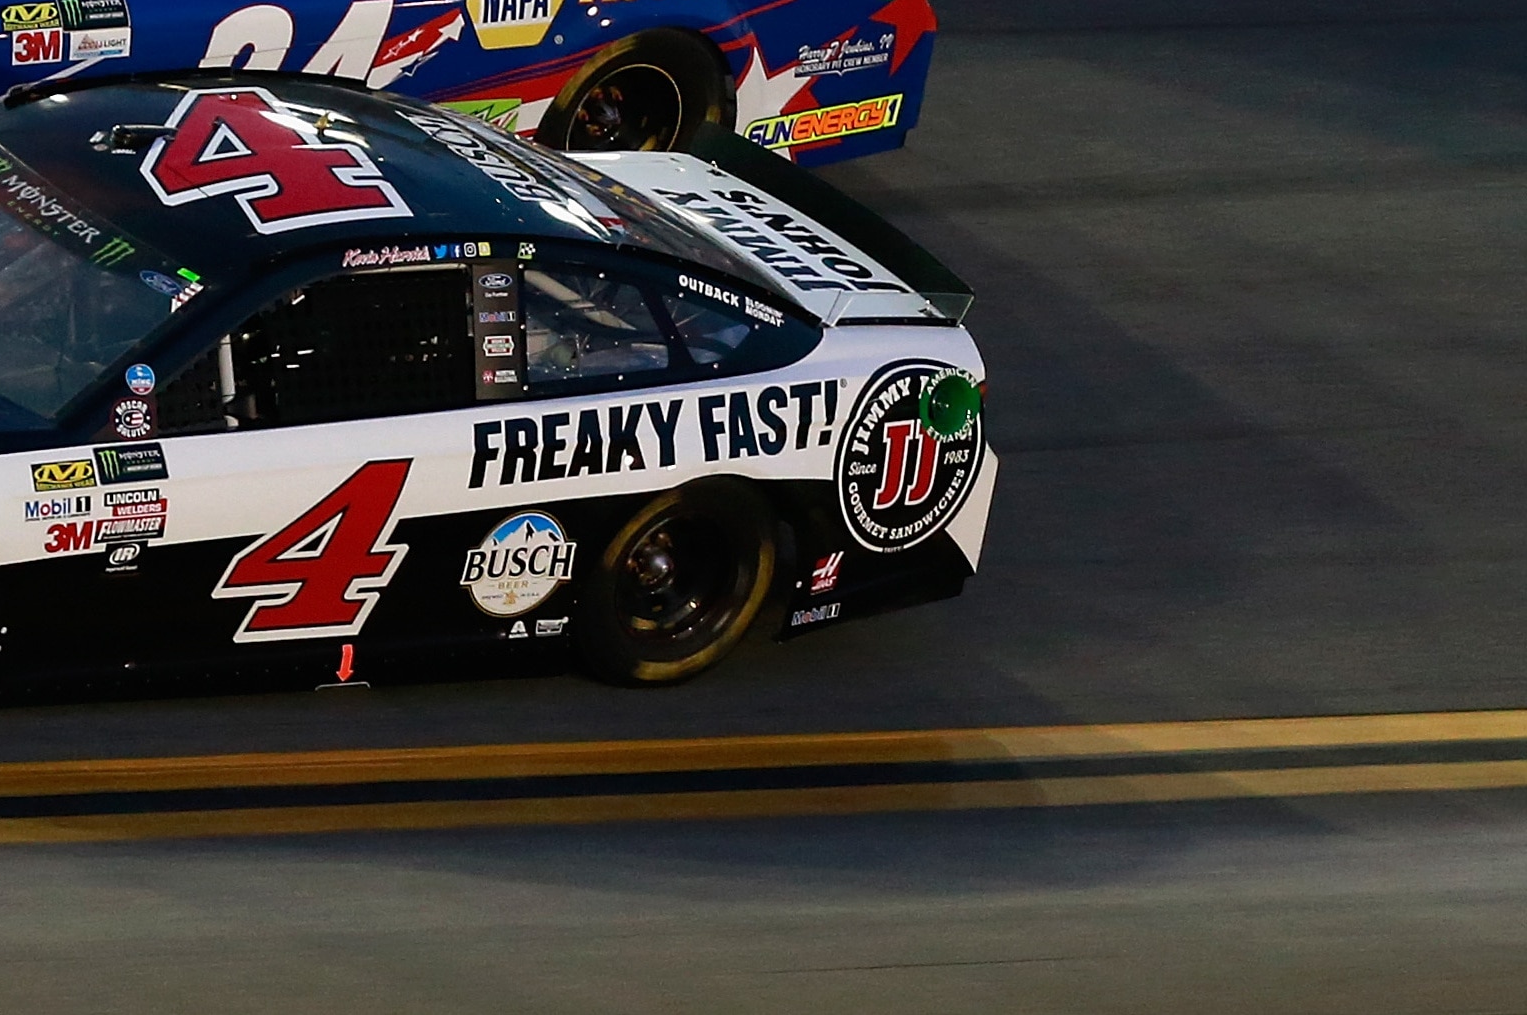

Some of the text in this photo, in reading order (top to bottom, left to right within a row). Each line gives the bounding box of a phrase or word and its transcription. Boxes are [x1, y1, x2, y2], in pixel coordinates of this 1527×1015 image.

[15, 30, 60, 62] 3M
[103, 38, 127, 47] LIGHT
[796, 53, 889, 74] HONORARY PIT CREW MEMBER
[138, 86, 415, 236] 4
[2, 174, 101, 244] MONSTER
[711, 190, 912, 294] JOHN'S
[679, 275, 739, 307] OUTBACK
[926, 367, 977, 396] AMERICAN
[115, 399, 148, 415] NASCAR
[852, 377, 911, 456] JIMMY
[117, 423, 151, 438] SALUTES
[468, 380, 839, 488] FREAKY FAST!
[119, 449, 160, 460] MONSTER
[848, 449, 970, 476] Since 1983
[873, 419, 940, 509] JJ
[25, 497, 71, 518] Mobil
[106, 489, 157, 505] LINCOLN
[117, 503, 162, 515] WELDERS
[848, 469, 965, 540] GOURMET SANDWICHES
[44, 521, 94, 553] 3M
[97, 517, 163, 541] FLOWMASTER
[211, 457, 414, 644] 4
[463, 544, 574, 582] BUSCH
[498, 581, 529, 590] BEER
[791, 605, 827, 626] Mobil
